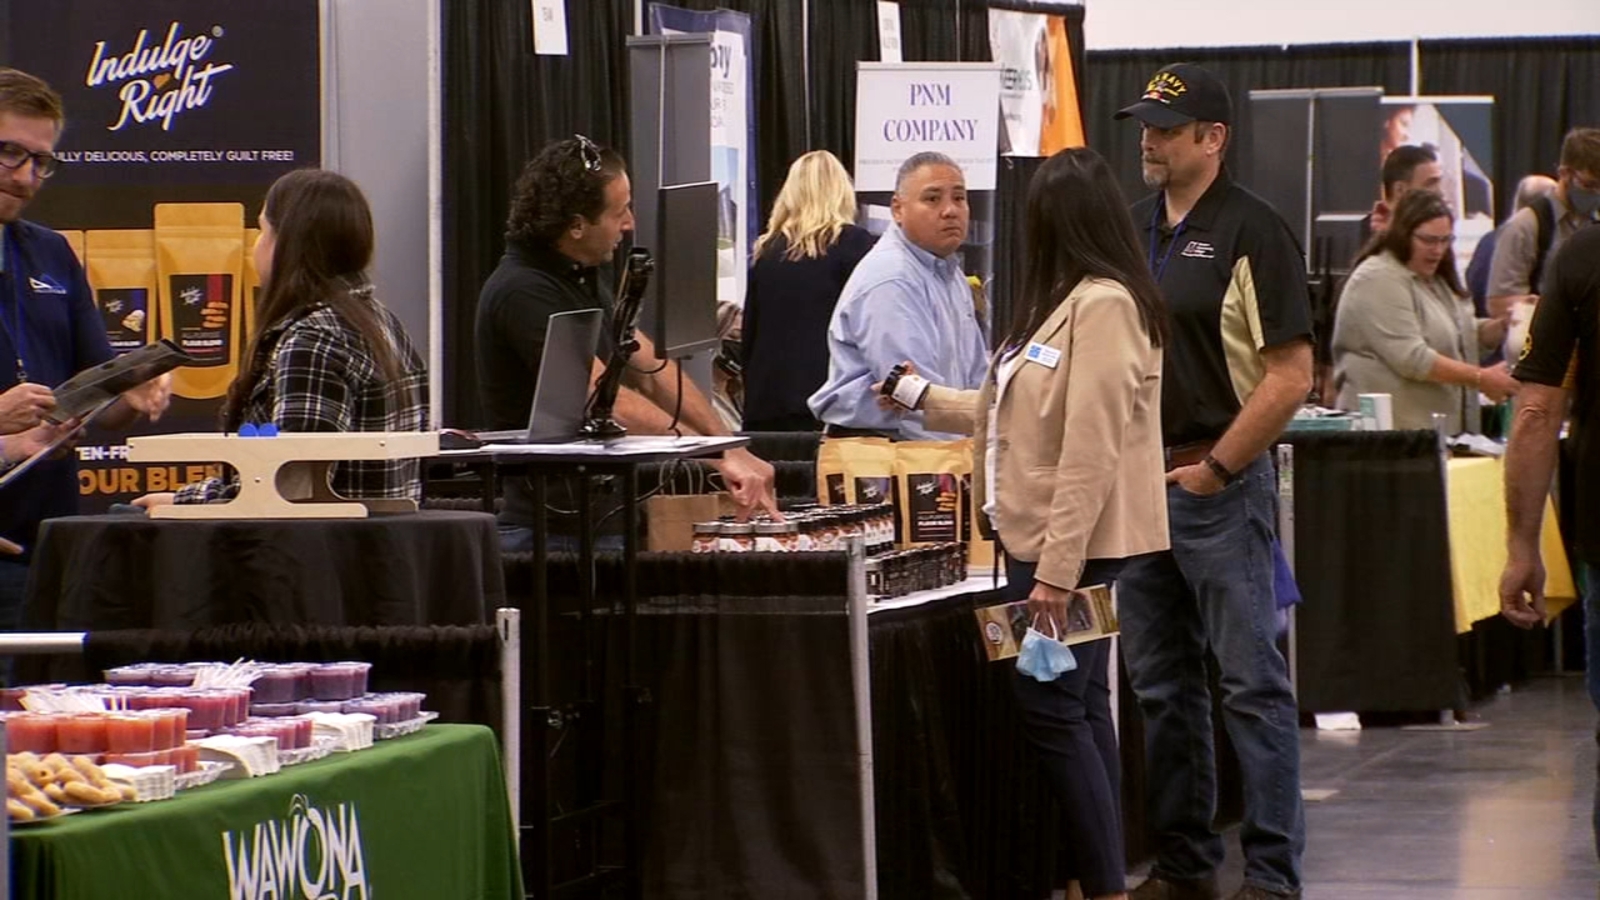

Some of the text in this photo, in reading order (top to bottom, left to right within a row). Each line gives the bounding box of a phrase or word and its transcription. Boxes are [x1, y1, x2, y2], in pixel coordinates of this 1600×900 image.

[106, 64, 233, 131] Right
[910, 83, 951, 106] PNM
[883, 119, 977, 142] COMPANY
[85, 151, 148, 162] DELICIOUS,
[151, 151, 222, 161] COMPLETELY
[226, 151, 258, 161] GUILT
[262, 150, 294, 161] FREE!
[222, 800, 368, 899] WAWONA
